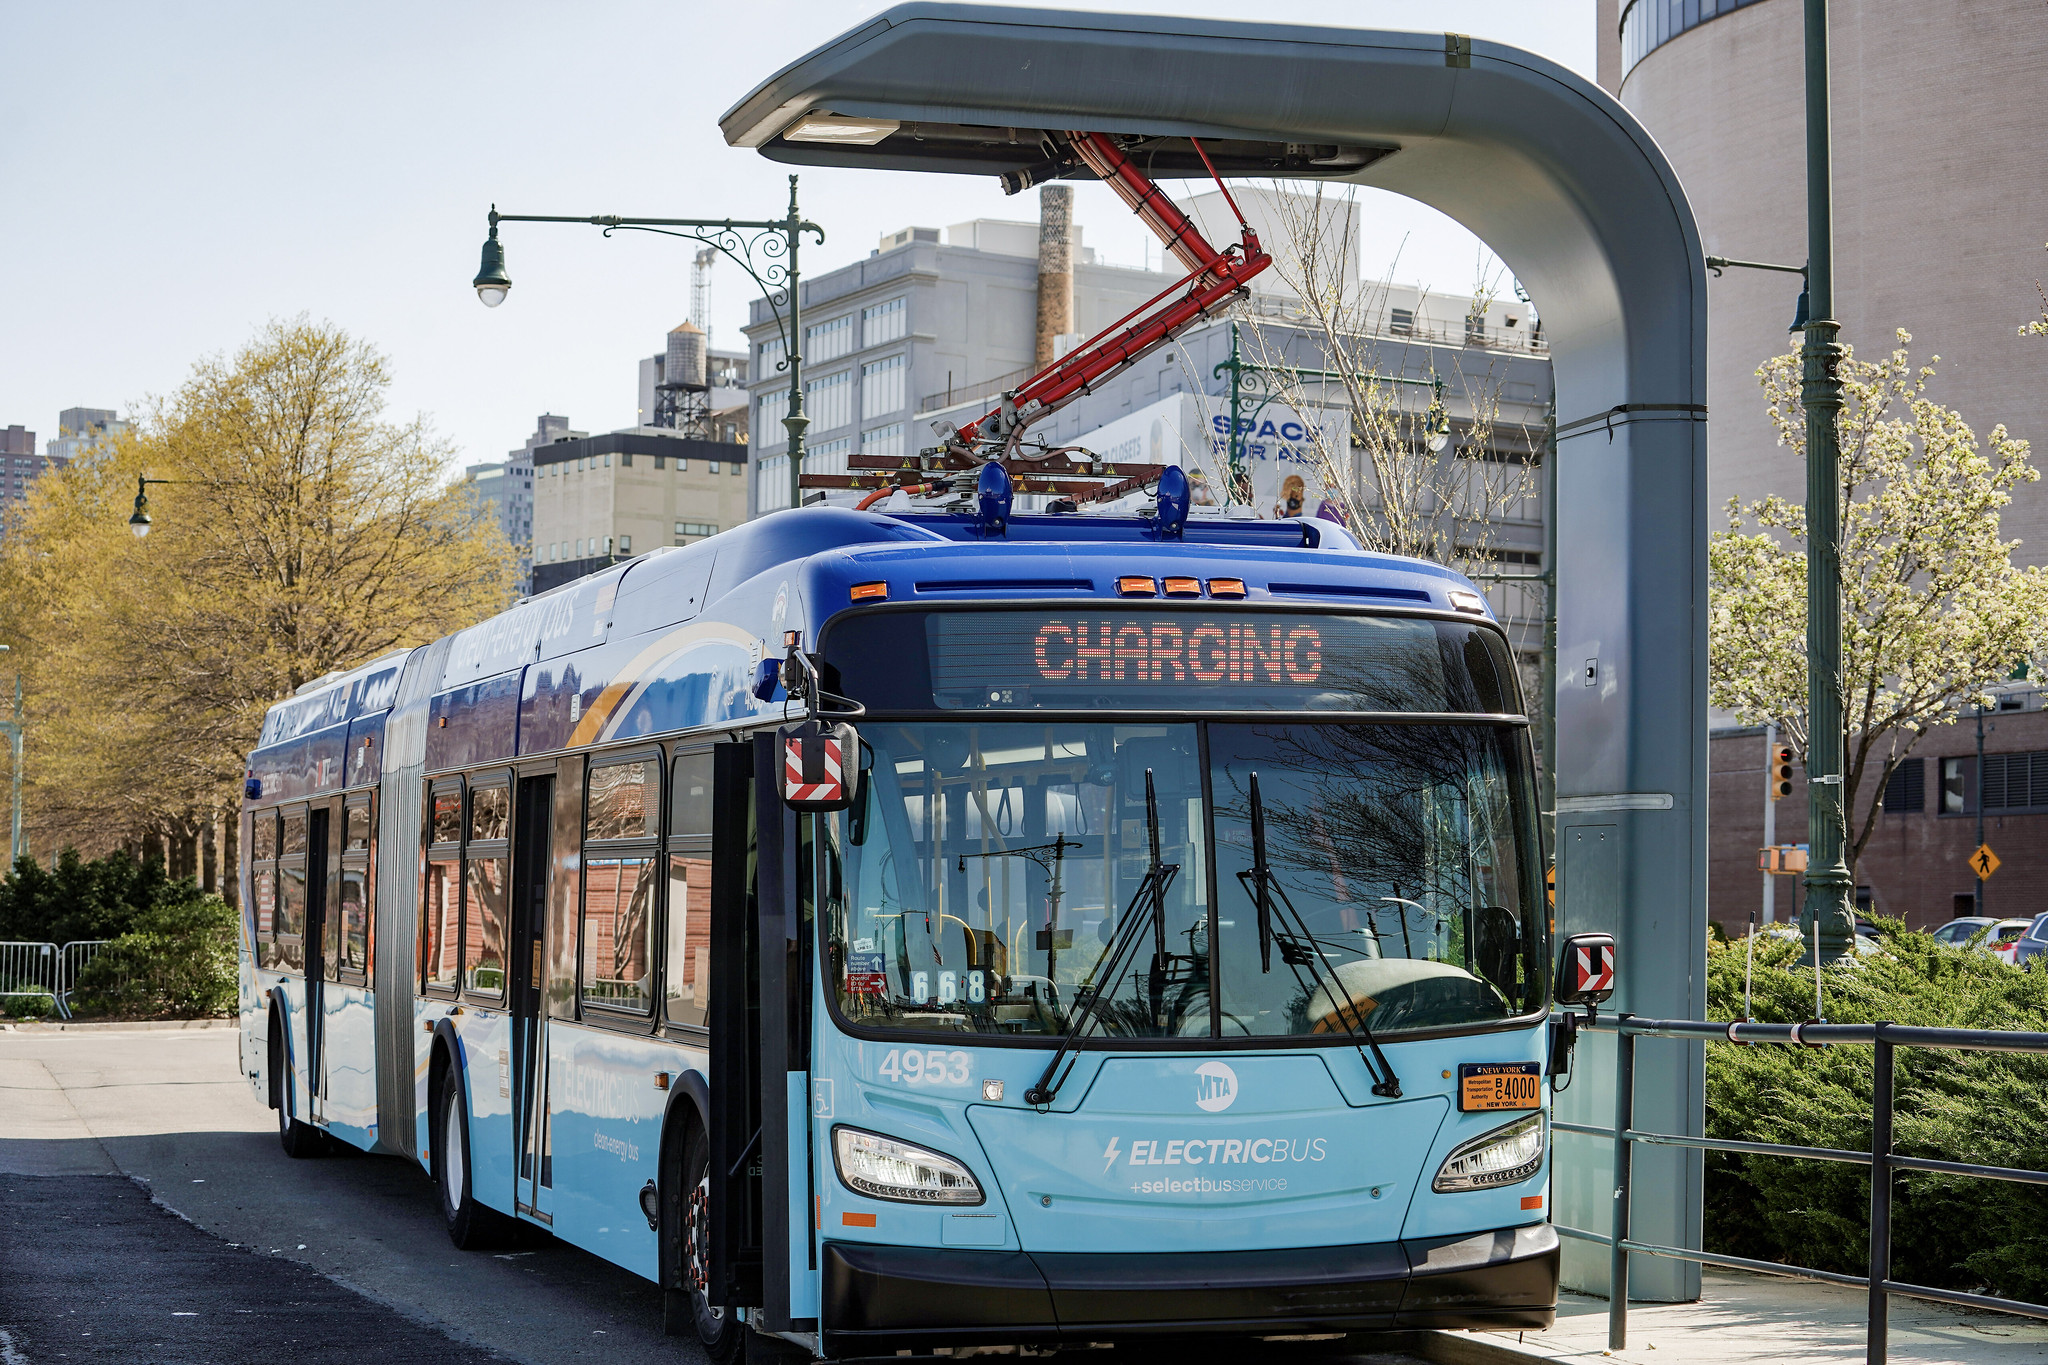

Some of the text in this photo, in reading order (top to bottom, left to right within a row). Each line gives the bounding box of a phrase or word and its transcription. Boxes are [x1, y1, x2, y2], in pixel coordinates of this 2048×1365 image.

[1035, 621, 1321, 682] CHARGING
[879, 1049, 970, 1084] 4953
[1482, 1066, 1522, 1075] NEW YORK
[1195, 1073, 1232, 1103] MTA
[594, 1128, 639, 1163] clean-energy bus
[1128, 1138, 1328, 1166] ELECTRICBUS
